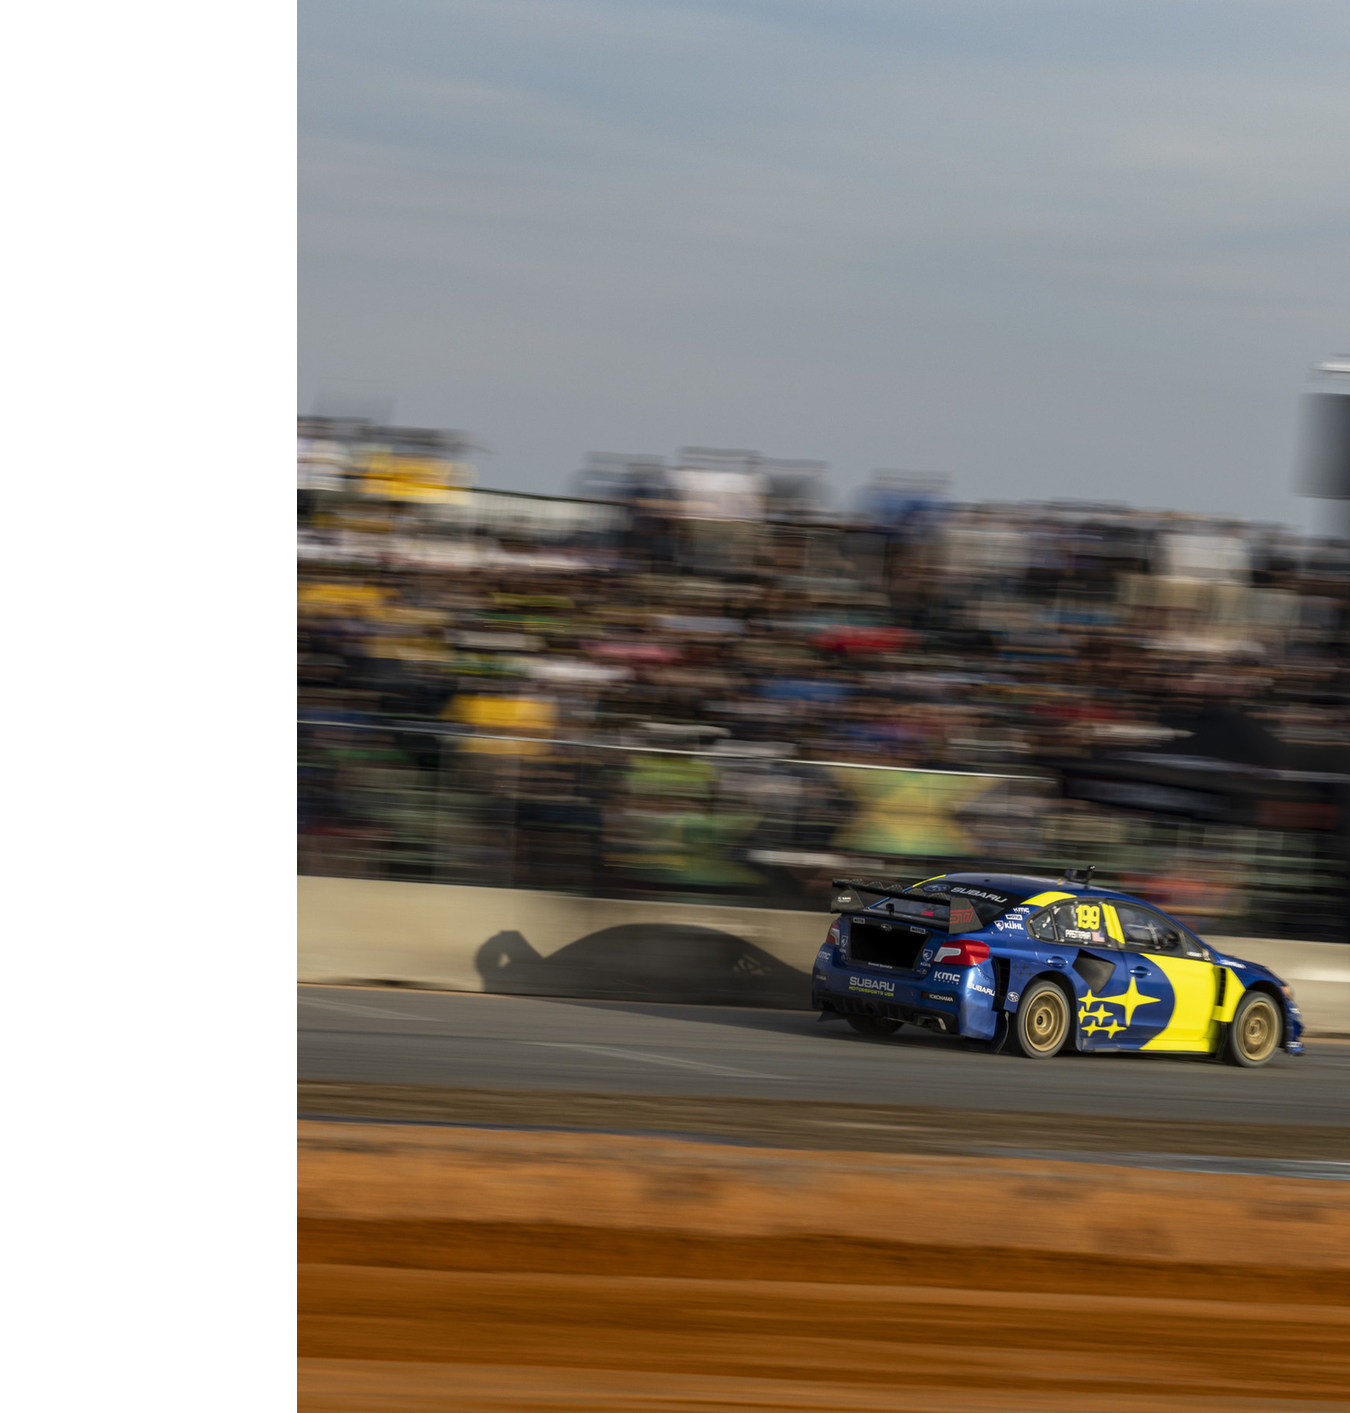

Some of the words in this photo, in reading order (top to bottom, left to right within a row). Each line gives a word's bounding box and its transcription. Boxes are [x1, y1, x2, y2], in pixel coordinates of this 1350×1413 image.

[950, 886, 1008, 903] SUBARU
[1075, 904, 1100, 930] 199
[850, 976, 895, 992] SUBARU
[934, 971, 960, 982] KMC
[967, 983, 996, 997] SUBARU
